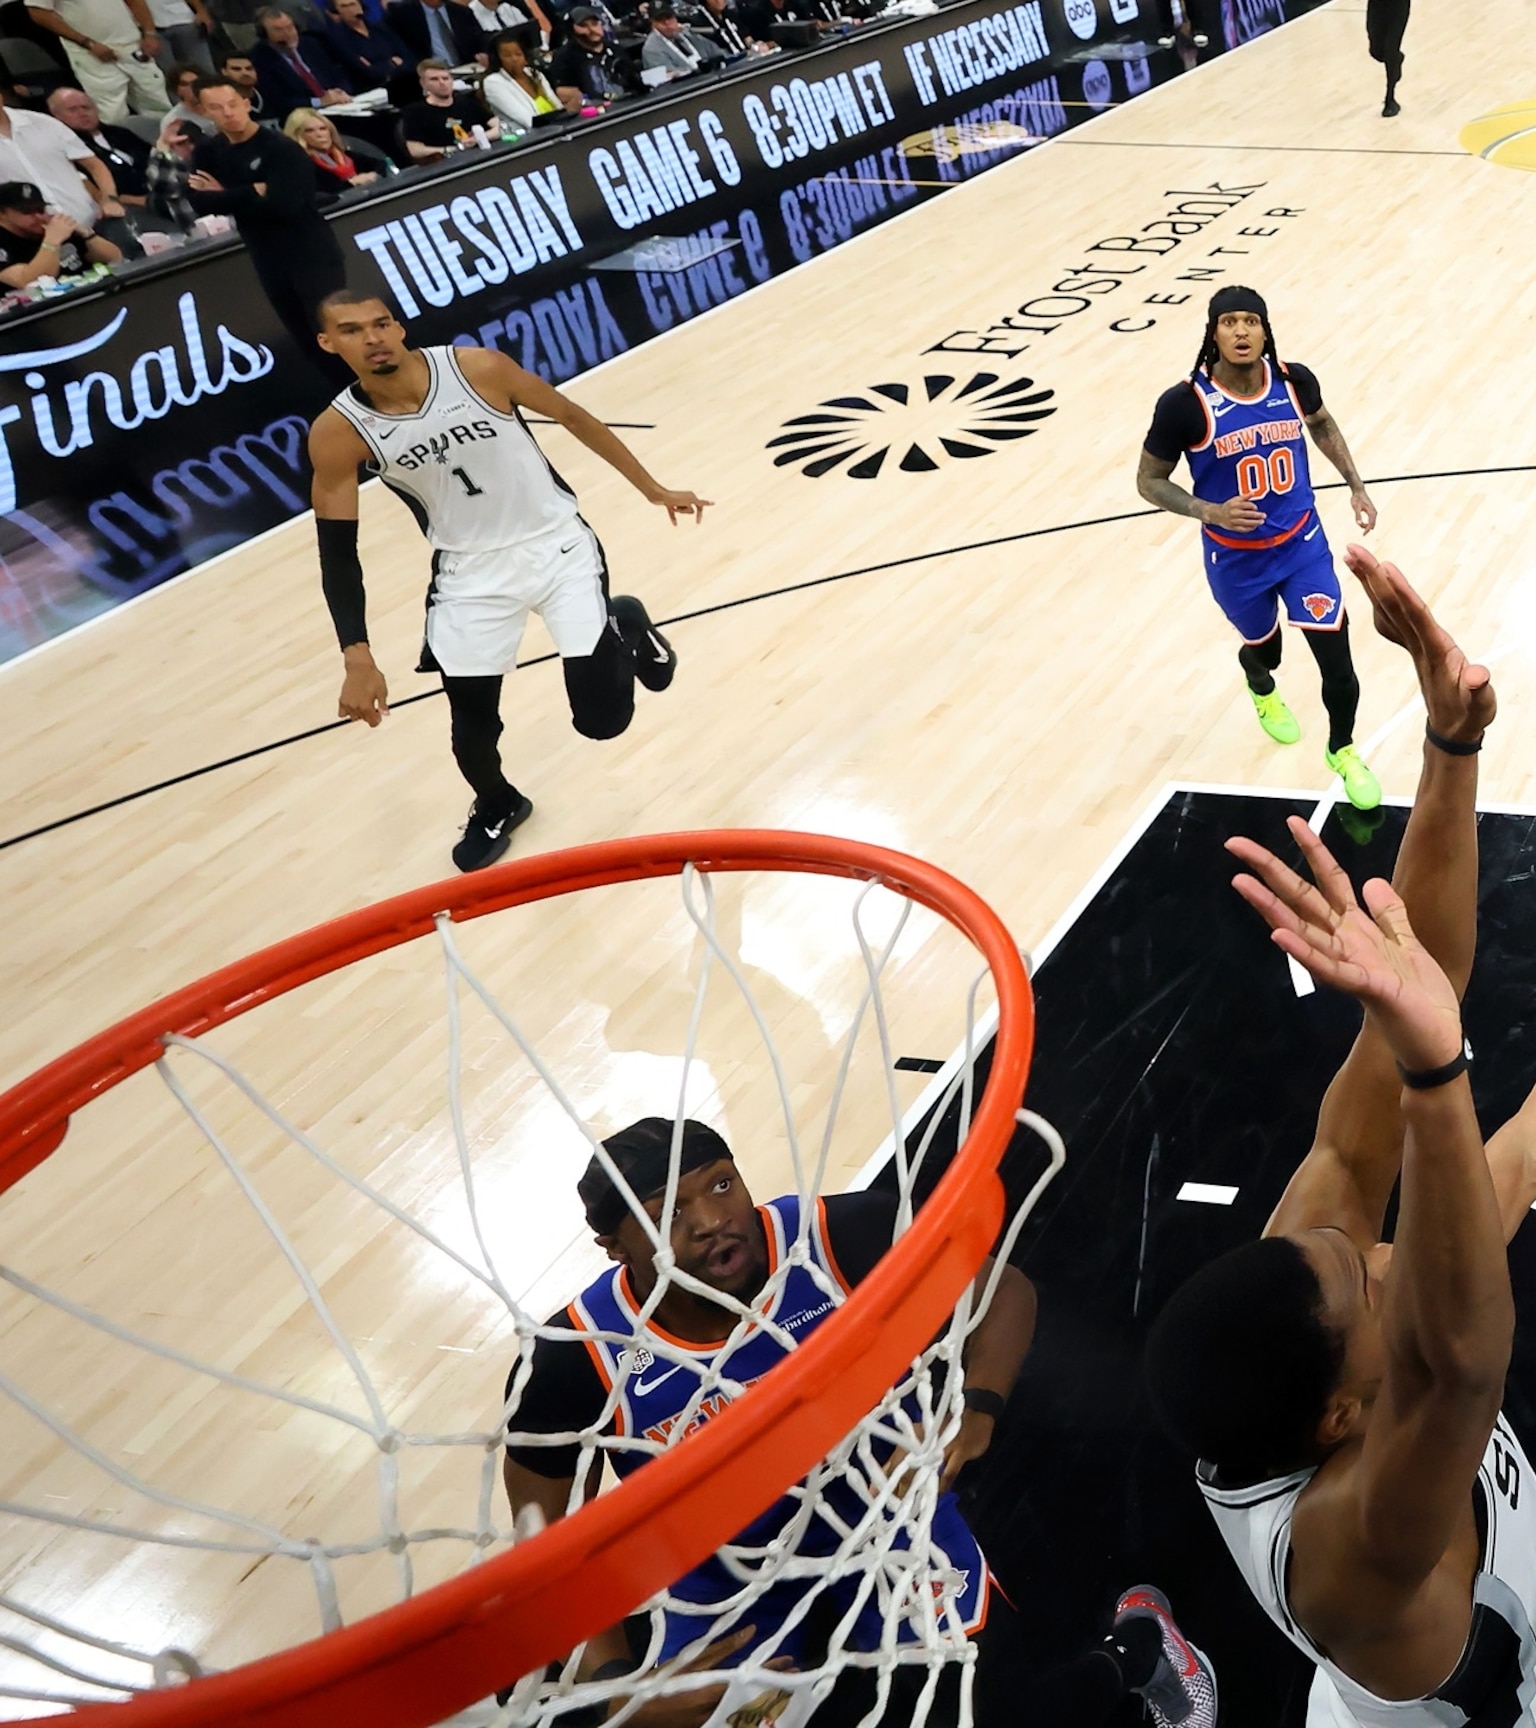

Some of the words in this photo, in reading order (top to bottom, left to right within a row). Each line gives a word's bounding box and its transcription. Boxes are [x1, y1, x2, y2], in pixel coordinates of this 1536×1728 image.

[1067, 1, 1093, 22] abc
[354, 164, 584, 320] TUESDAY
[588, 118, 716, 230] GAME
[698, 109, 742, 187] 6
[742, 72, 867, 169] 8:30PM
[852, 61, 896, 128] ET
[903, 41, 938, 106] IF
[928, 0, 1050, 97] NECESSARY
[920, 262, 1147, 359] Frost
[1084, 181, 1268, 256] Bank
[1109, 207, 1307, 332] CENTER
[396, 420, 497, 471] SPURS
[1214, 426, 1263, 458] NEW
[1257, 419, 1301, 446] YORK
[452, 466, 484, 497] 1
[1236, 447, 1296, 501] 00
